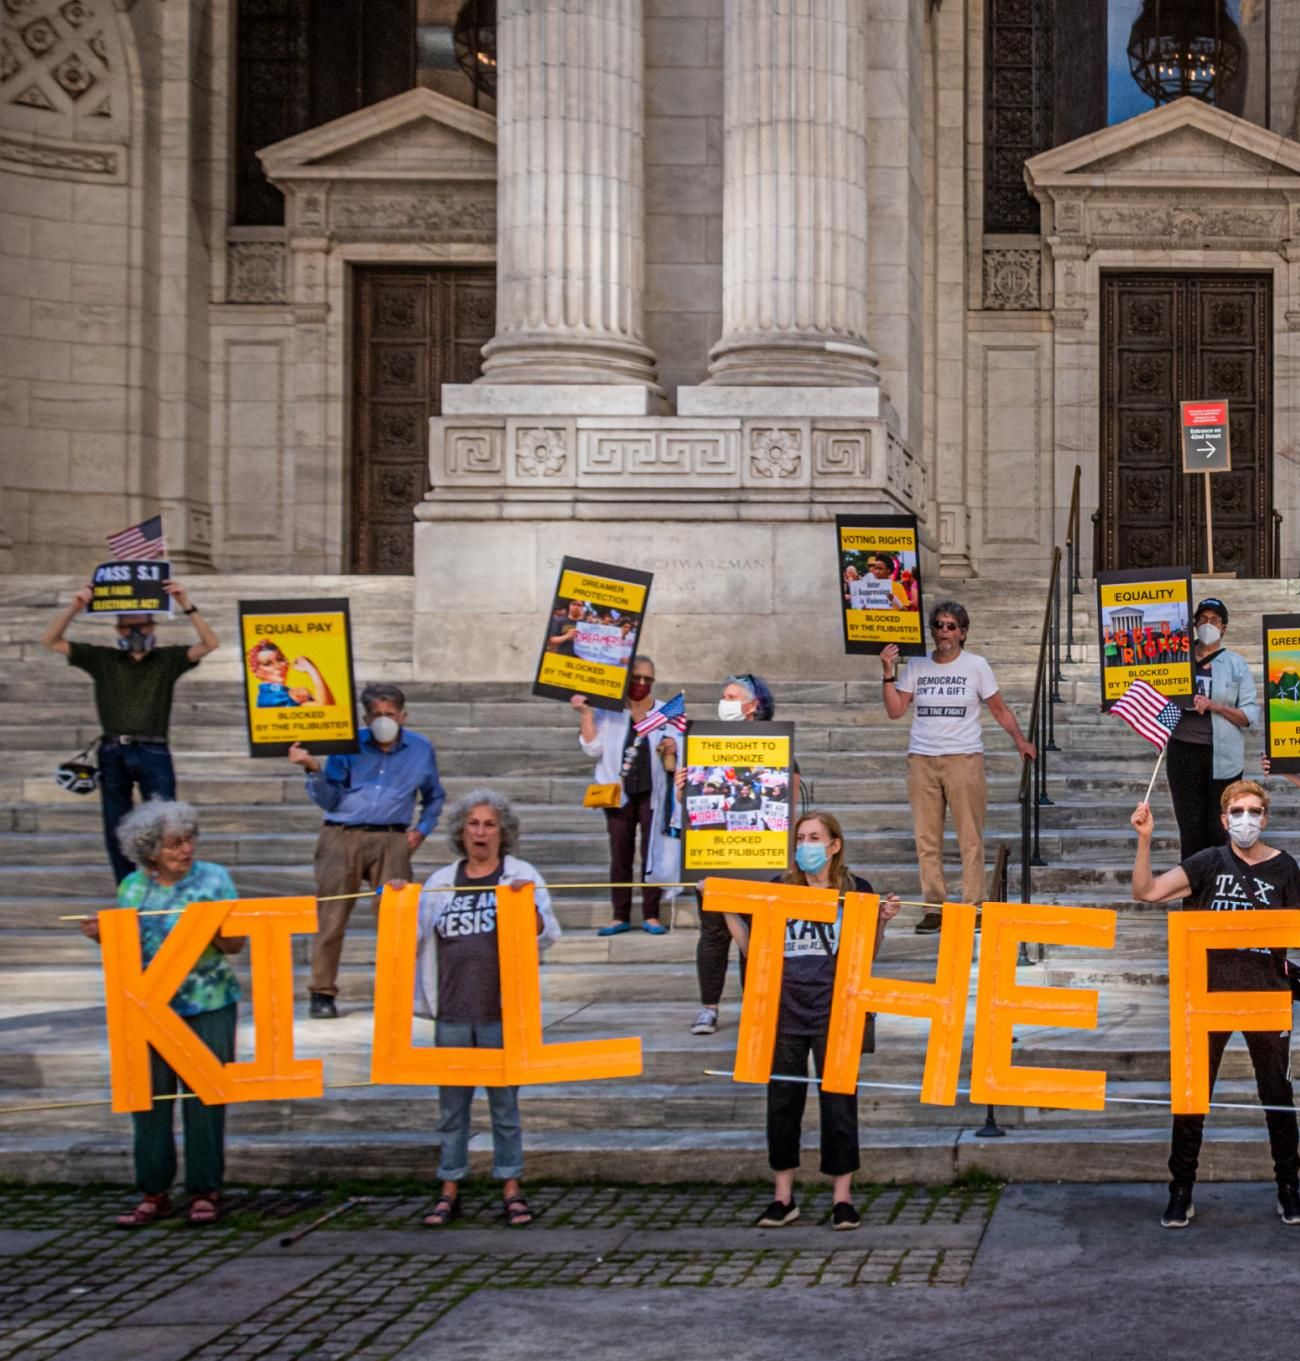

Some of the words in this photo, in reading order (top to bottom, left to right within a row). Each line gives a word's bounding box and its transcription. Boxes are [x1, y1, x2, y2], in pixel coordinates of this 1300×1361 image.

[842, 535, 876, 545] VOTING
[878, 536, 913, 545] RIGHTS
[95, 565, 131, 582] PASS
[137, 564, 159, 581] S.1
[581, 578, 625, 593] DREAMER
[572, 587, 629, 606] PROTECTION
[1115, 589, 1175, 602] EQUALITY
[865, 614, 901, 623] BLOCKED
[255, 623, 303, 635] EQUAL
[307, 622, 333, 633] PAY
[861, 624, 875, 632] THE
[876, 624, 919, 633] FILIBUSTER
[1123, 636, 1191, 664] RIGHTS
[564, 661, 606, 676] BLOCKED
[1128, 669, 1169, 678] BLOCKED
[543, 667, 555, 675] BY
[557, 670, 573, 680] THE
[574, 673, 622, 689] FILIBUSTER
[917, 676, 968, 686] DEMOCRACY
[1123, 680, 1134, 688] TH
[917, 687, 936, 696] ISN'T
[938, 687, 944, 695] A
[946, 687, 966, 696] GIFT
[277, 711, 325, 720] BLOCKED
[929, 707, 943, 715] THE
[944, 707, 965, 715] FIGHT
[255, 724, 268, 732] BY
[271, 723, 290, 731] THE
[292, 720, 349, 730] FILIBUSTER
[701, 741, 722, 750] THE
[725, 741, 758, 751] RIGHT
[762, 742, 776, 751] TO
[1274, 738, 1287, 746] BY
[712, 754, 765, 763] UNIONIZE
[713, 835, 762, 844] BLOCKED
[689, 848, 702, 857] BY
[706, 848, 725, 857] THE
[728, 848, 785, 857] FILIBUSTER
[476, 891, 497, 909] AN
[99, 882, 642, 1112] KILL
[702, 876, 1117, 1111] THE
